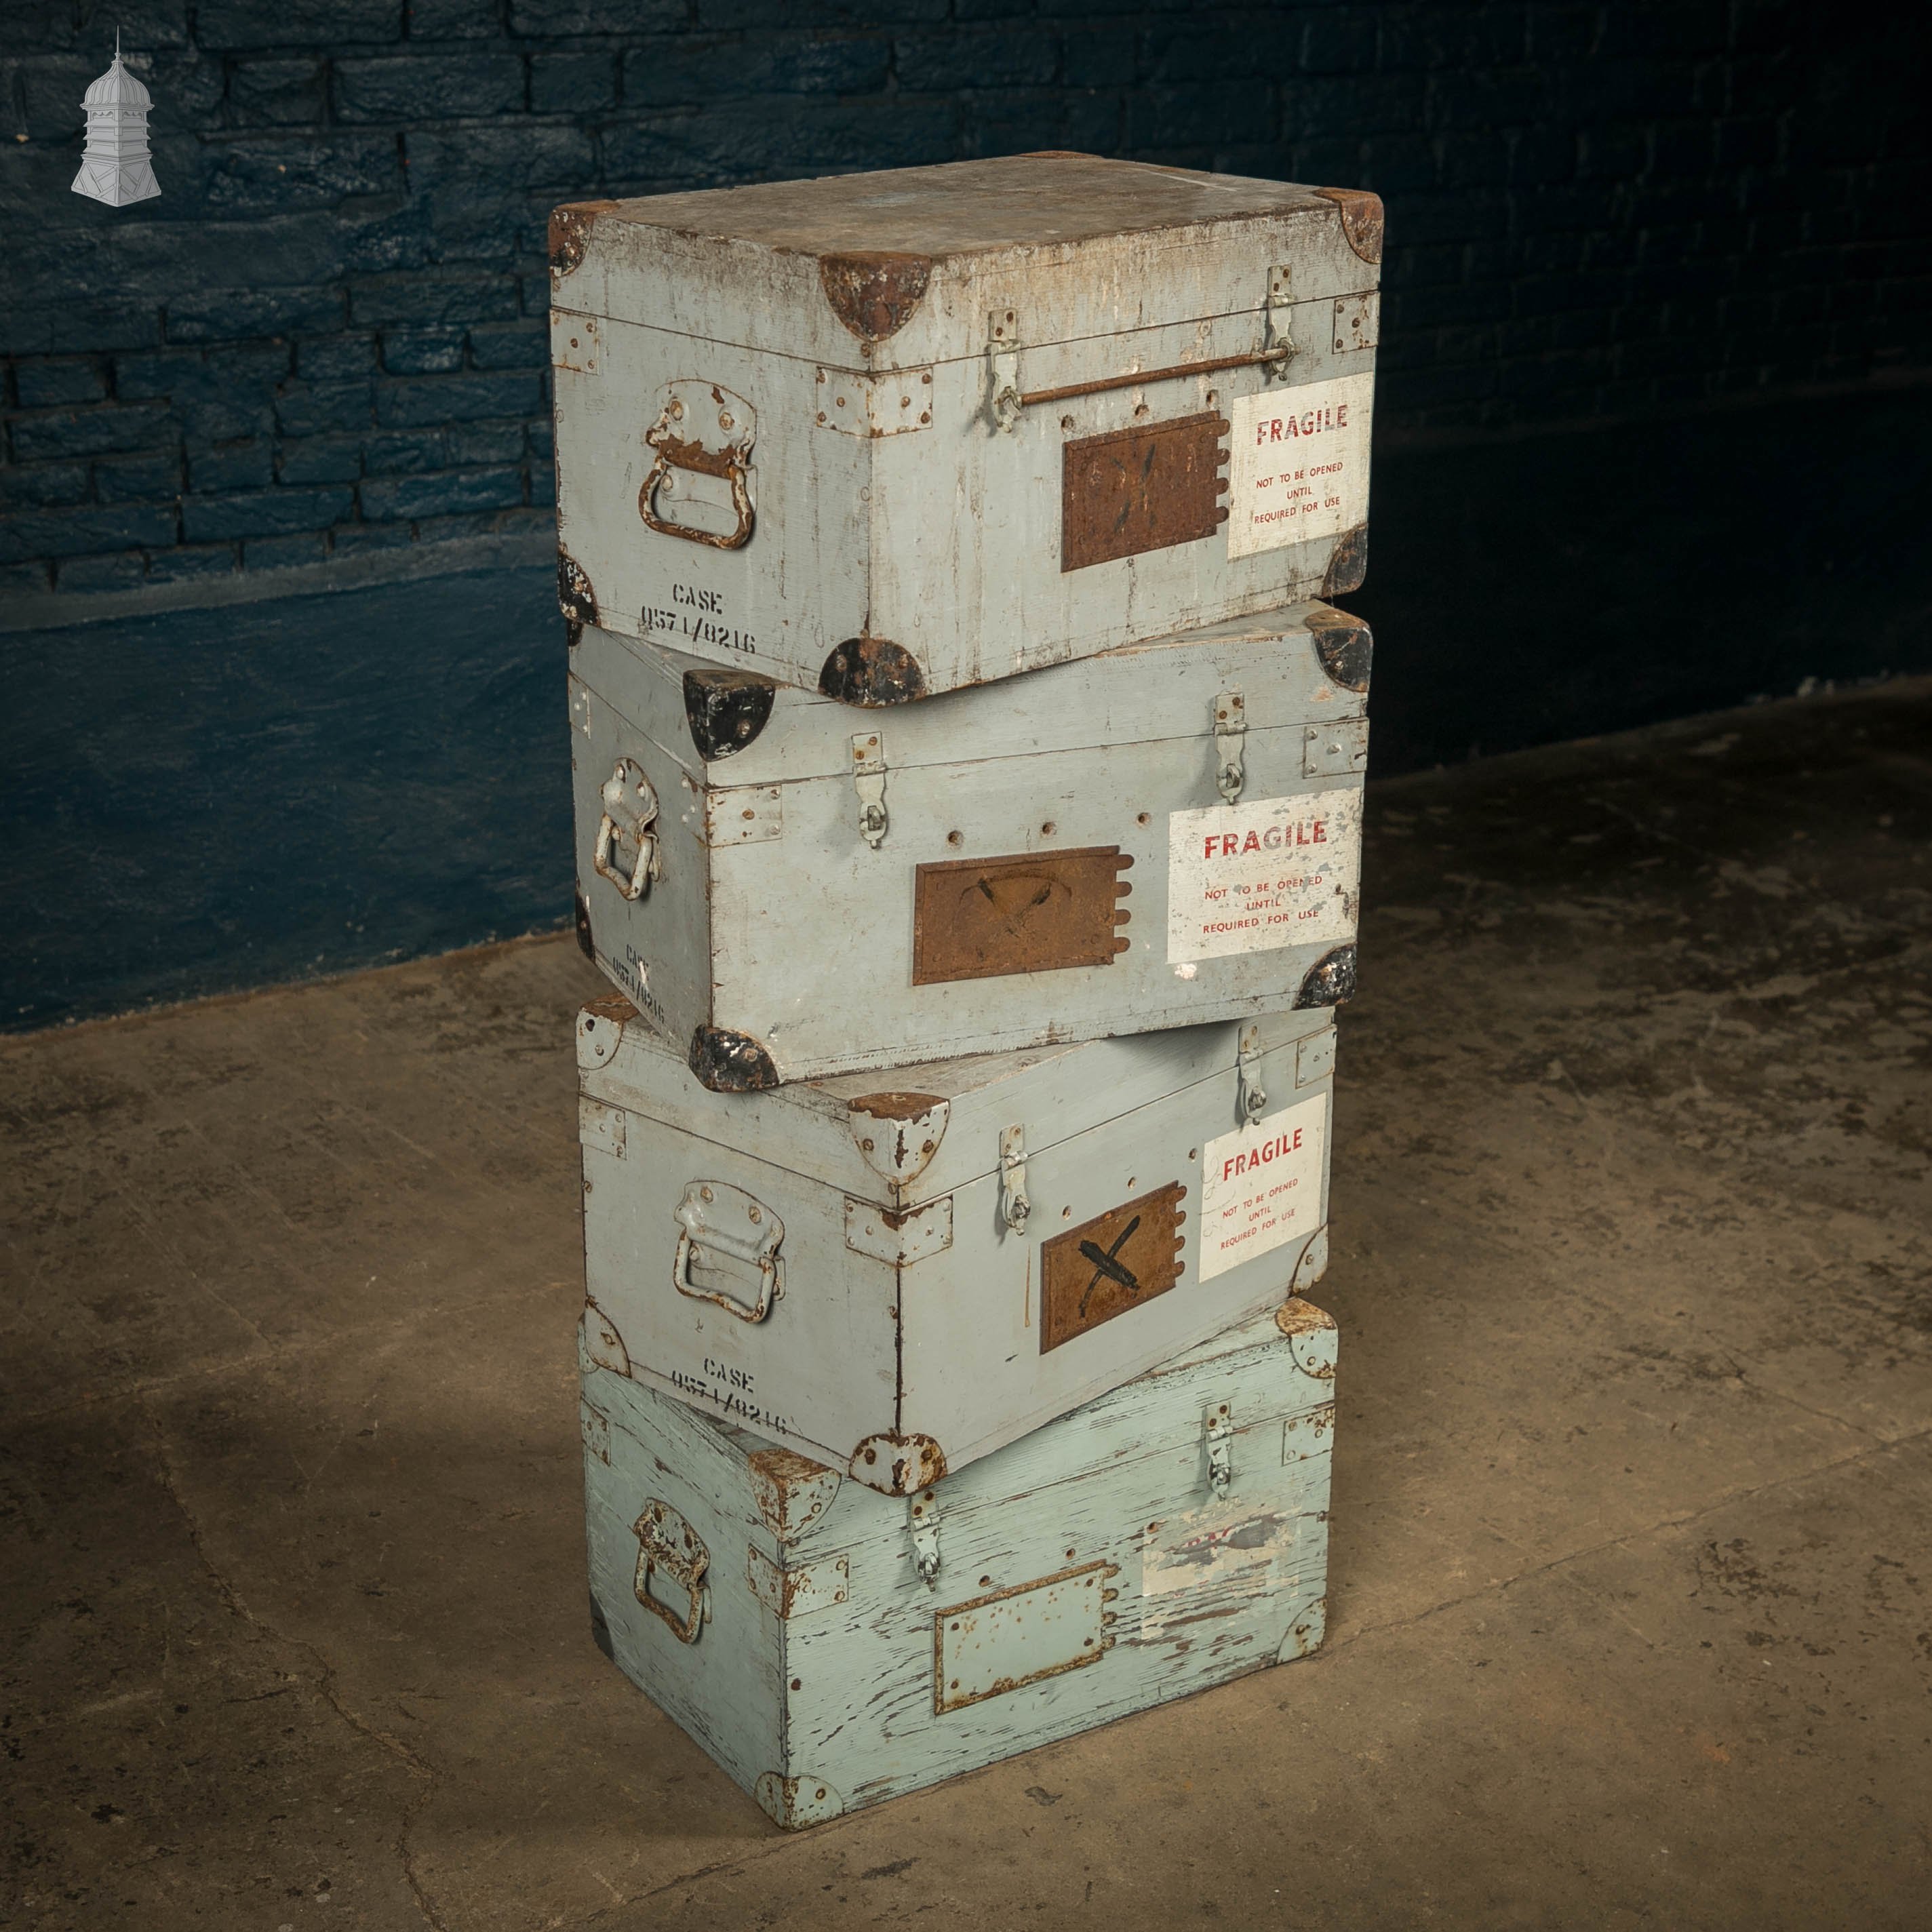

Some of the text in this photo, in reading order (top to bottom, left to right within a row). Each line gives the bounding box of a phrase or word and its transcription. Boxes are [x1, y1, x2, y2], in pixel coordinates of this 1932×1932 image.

[1257, 404, 1348, 446] FRAGILE
[1256, 462, 1343, 489] NOT TO BE OPENED
[1286, 486, 1313, 499] UNTIL
[1255, 496, 1340, 524] REQUIRED FOR USE
[673, 583, 723, 614] CASE
[1204, 820, 1328, 860] FRAGILE
[1204, 888, 1228, 900] NOT
[1234, 884, 1251, 896] O
[1257, 883, 1269, 893] BE
[1246, 899, 1281, 911] UNTIL
[1203, 909, 1320, 934] REQUIRED FOR USE
[1223, 1128, 1303, 1181] FRAGILE
[1223, 1178, 1299, 1219] NOT TO BE OPENED
[1248, 1206, 1271, 1222] UNTIL
[1221, 1208, 1296, 1250] REQUIRED FOR USE
[704, 1358, 754, 1394] CASE
